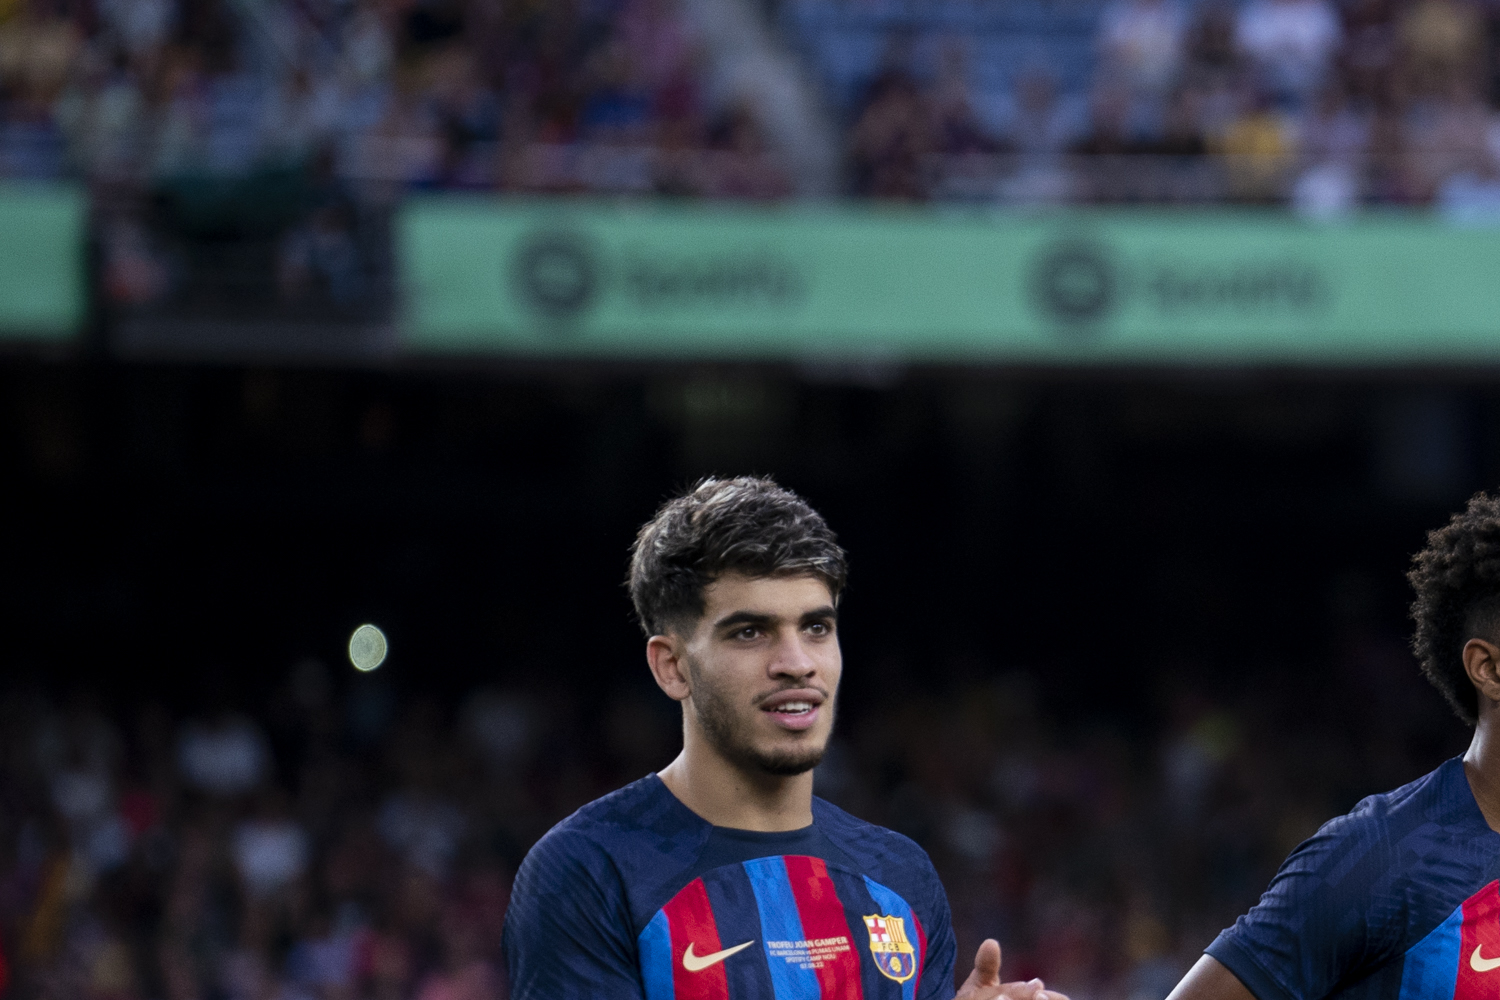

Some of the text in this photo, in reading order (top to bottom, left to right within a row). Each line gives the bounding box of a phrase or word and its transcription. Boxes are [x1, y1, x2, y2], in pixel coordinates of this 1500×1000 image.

[767, 937, 848, 949] TROFEU JOAN GAMPER
